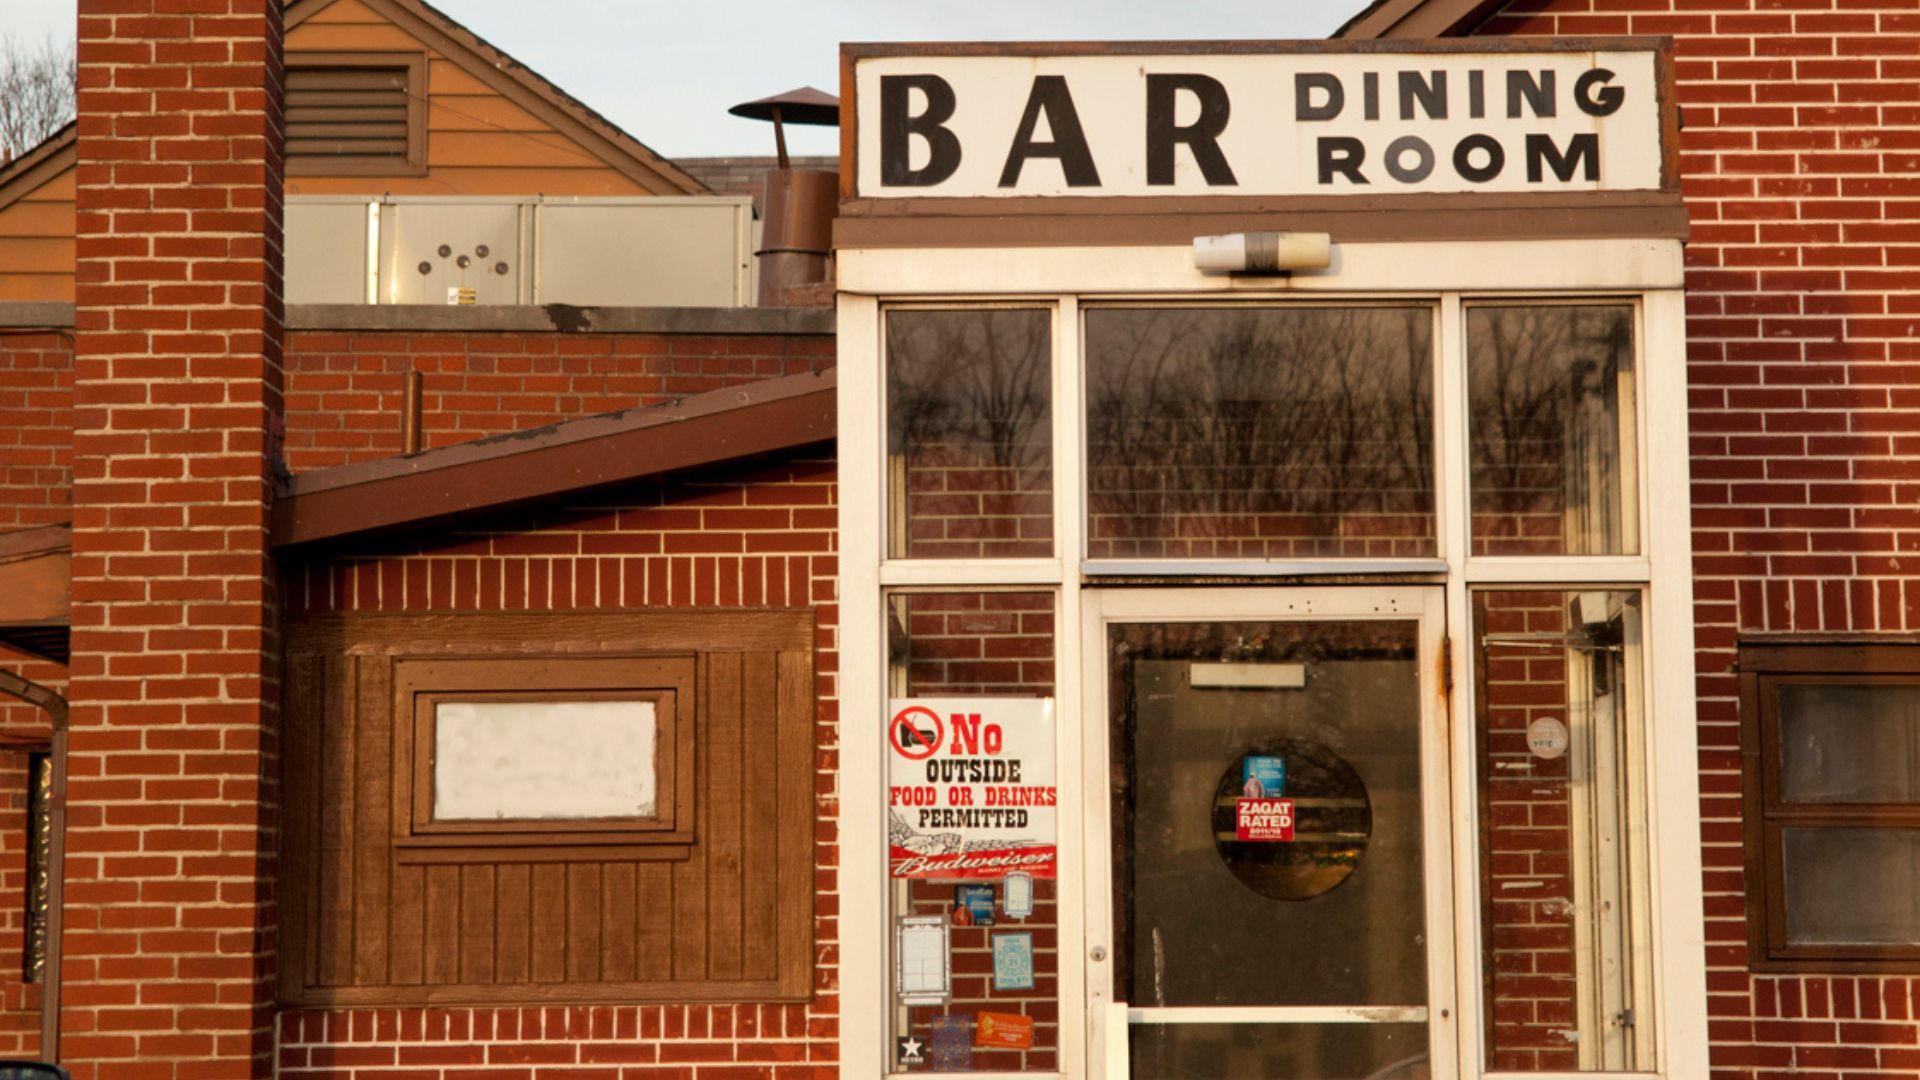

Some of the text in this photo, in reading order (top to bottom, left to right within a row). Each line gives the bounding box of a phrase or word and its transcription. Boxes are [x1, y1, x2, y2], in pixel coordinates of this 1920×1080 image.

[1295, 68, 1625, 121] DINING
[880, 73, 1239, 188] BAR
[1318, 133, 1601, 184] ROOM
[950, 713, 1003, 756] No
[926, 759, 1021, 783] OUTSIDE
[890, 786, 1057, 807] FOOD OR DRINKS
[1239, 802, 1291, 814] ZAGAT
[919, 809, 1028, 829] PERMITTED
[1240, 815, 1291, 828] RATED
[894, 851, 1054, 876] Budweiser
